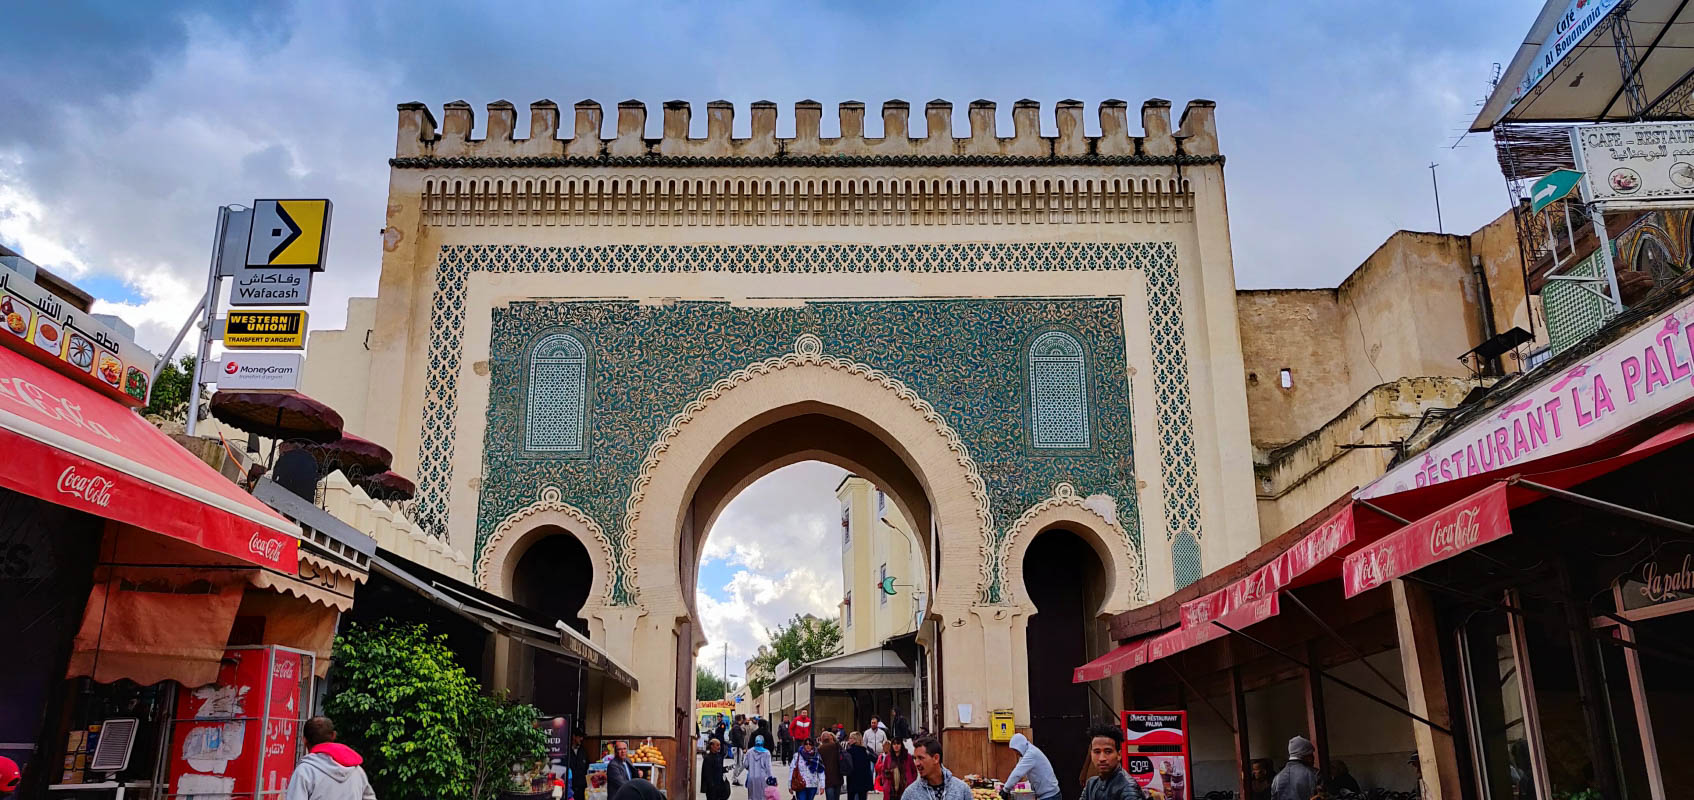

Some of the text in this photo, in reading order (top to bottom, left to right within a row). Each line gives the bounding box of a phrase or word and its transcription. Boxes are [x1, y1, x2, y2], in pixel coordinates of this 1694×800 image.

[1556, 8, 1576, 35] Café
[1545, 6, 1601, 68] Al Bouanania
[1588, 132, 1623, 148] CAFE
[240, 273, 300, 286] وفاكاش
[239, 287, 299, 299] Wafacash
[230, 315, 288, 324] WESTERN
[62, 315, 119, 354] مطعم
[247, 323, 288, 332] UNION
[240, 365, 293, 375] MoneyGram
[1415, 397, 1562, 489] RESTAURANT
[1572, 374, 1616, 429] LA
